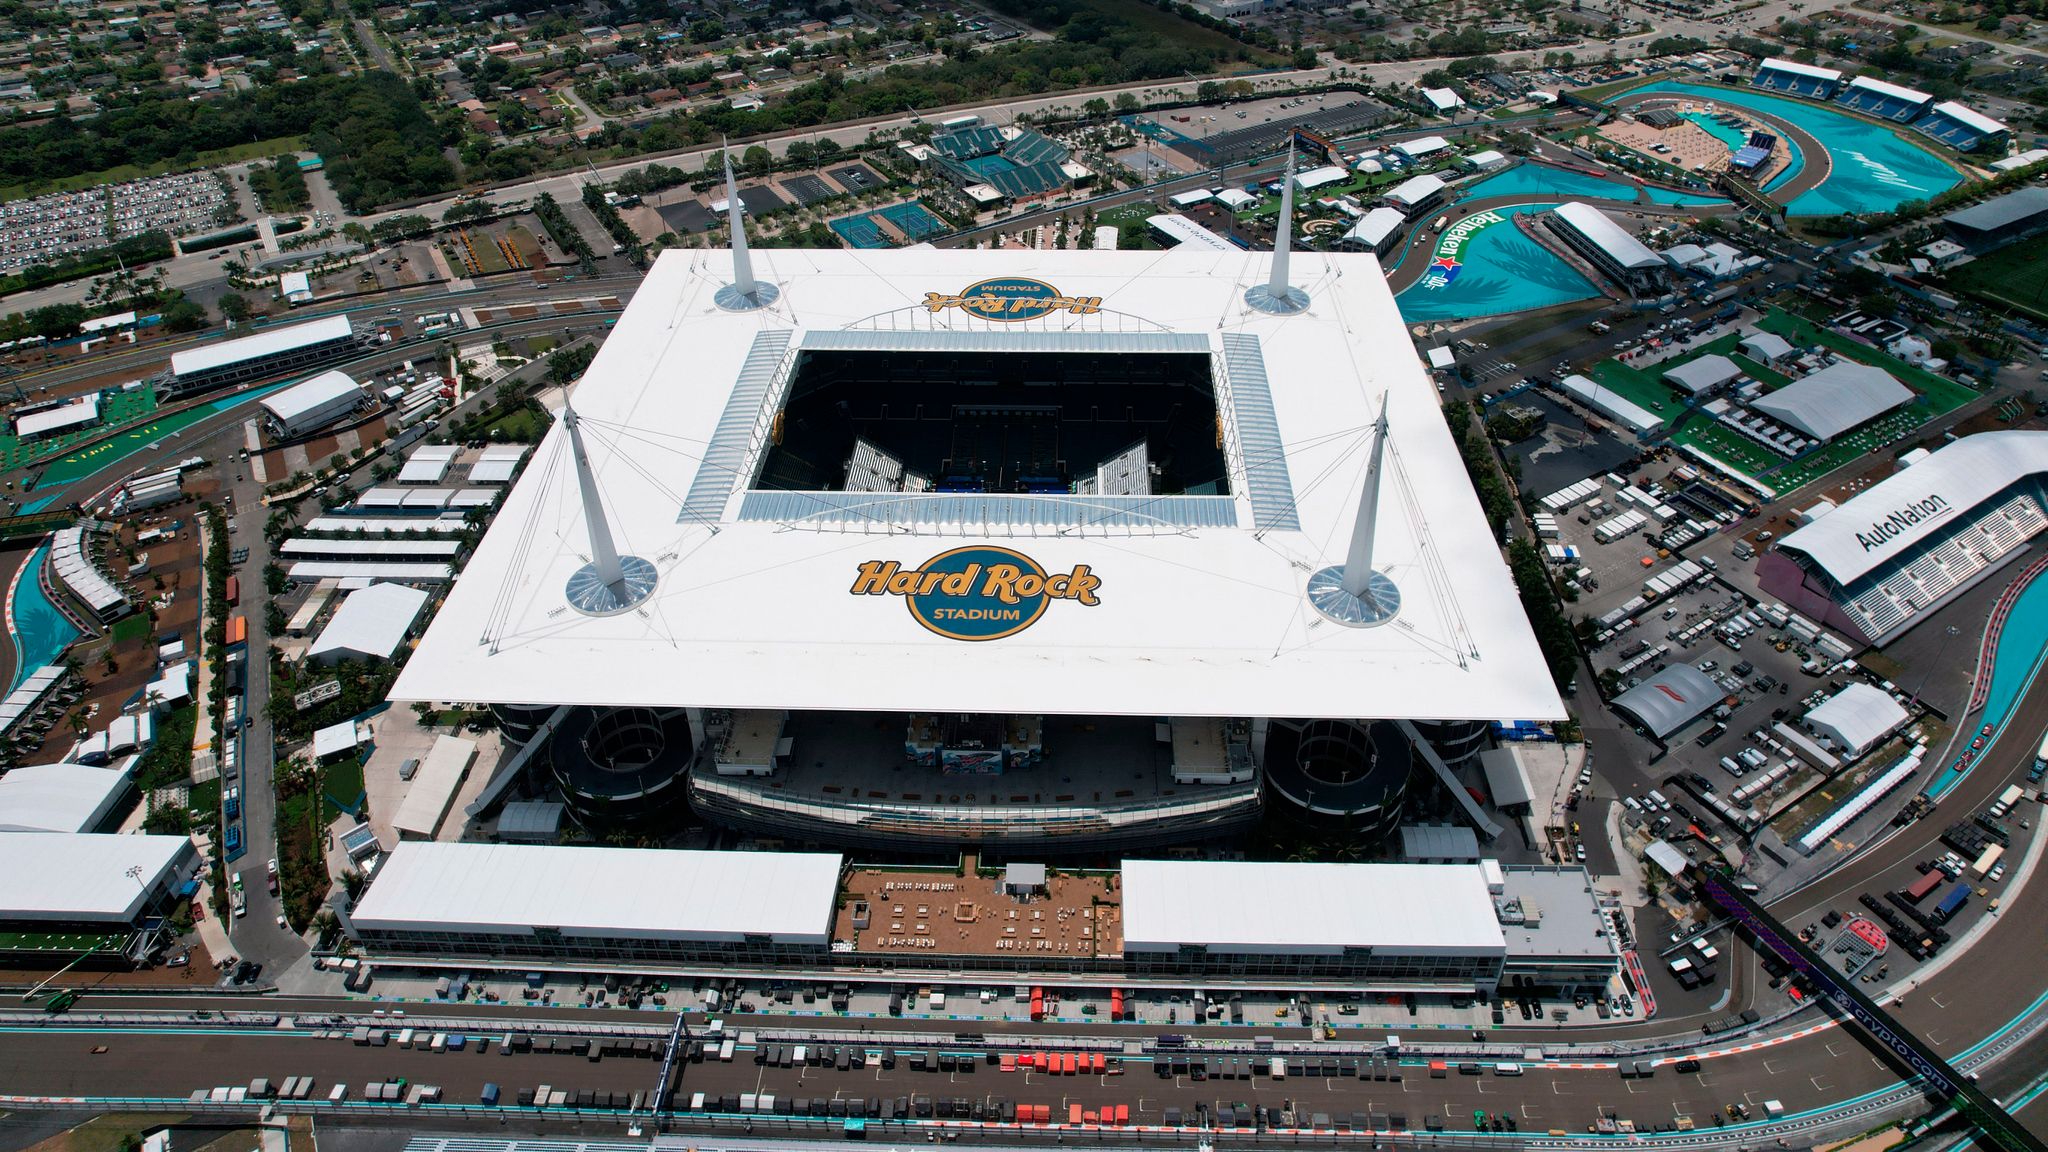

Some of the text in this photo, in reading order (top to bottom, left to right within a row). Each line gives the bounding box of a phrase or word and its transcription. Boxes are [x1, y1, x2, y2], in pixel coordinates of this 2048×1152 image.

[1440, 211, 1506, 255] Heineken
[921, 292, 1103, 314] Hard Rock
[1855, 494, 1948, 553] AutoNation
[850, 560, 1102, 607] Hard Rock
[933, 608, 1020, 620] STADIUM
[1855, 1008, 1948, 1091] crypto.com
